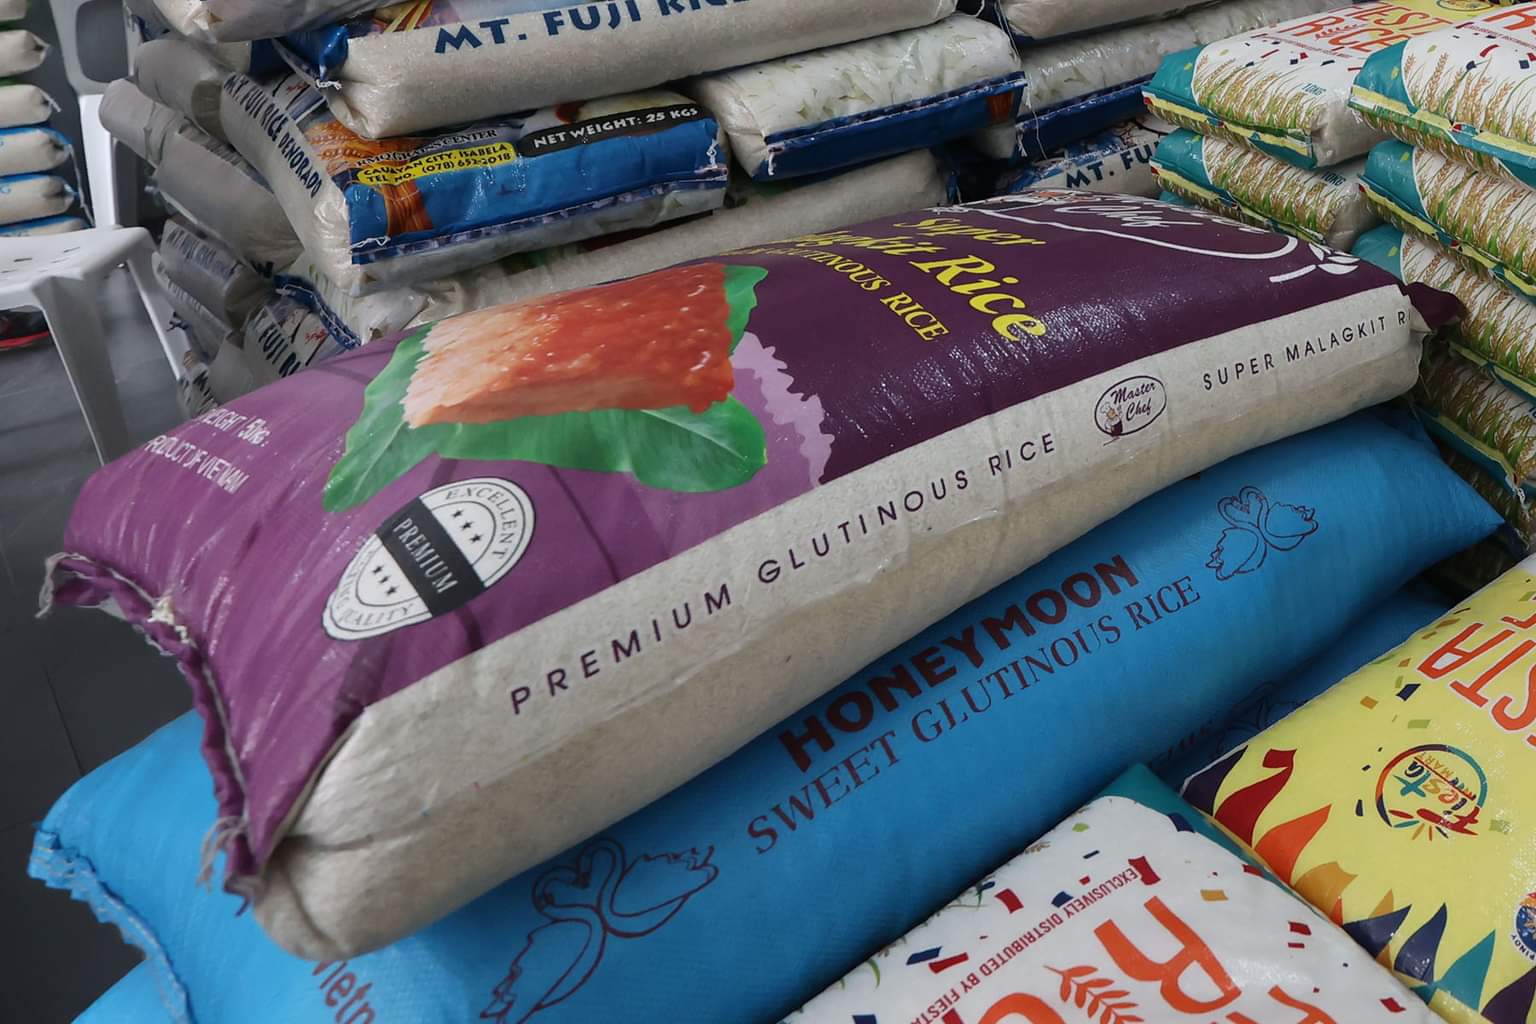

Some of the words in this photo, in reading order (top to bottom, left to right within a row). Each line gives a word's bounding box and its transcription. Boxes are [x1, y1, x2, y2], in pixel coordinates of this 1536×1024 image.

[434, 19, 529, 55] MT.
[261, 102, 289, 142] RICE
[278, 131, 322, 198] DENORADO
[459, 144, 508, 157] ISABELA
[533, 130, 568, 149] NET
[569, 116, 642, 138] WEIGHT:
[645, 111, 666, 124] 25
[669, 107, 699, 119] KGS
[422, 161, 456, 174] (078)
[458, 152, 512, 168] 652-2018
[881, 291, 950, 342] RICE
[909, 254, 1048, 342] Rice
[1203, 352, 1276, 392] SUPER
[1285, 315, 1389, 362] MALAGKIT
[1111, 380, 1157, 406] Master
[1125, 398, 1153, 422] Chef
[445, 486, 517, 560] EXCELLENT
[392, 517, 459, 594] PREMIUM
[508, 583, 734, 716] PREMIUM
[757, 468, 971, 586] GLUTINOUS
[989, 431, 1058, 476] RICE
[774, 553, 1139, 773] HONEYMOON
[744, 722, 910, 855] SWEET
[911, 616, 1124, 744] GLUTINOUS
[1128, 573, 1204, 636] RICE
[1064, 867, 1140, 920] EXCLUSIVELY
[978, 910, 1064, 978] DISTRIBUTED
[961, 970, 982, 995] BY
